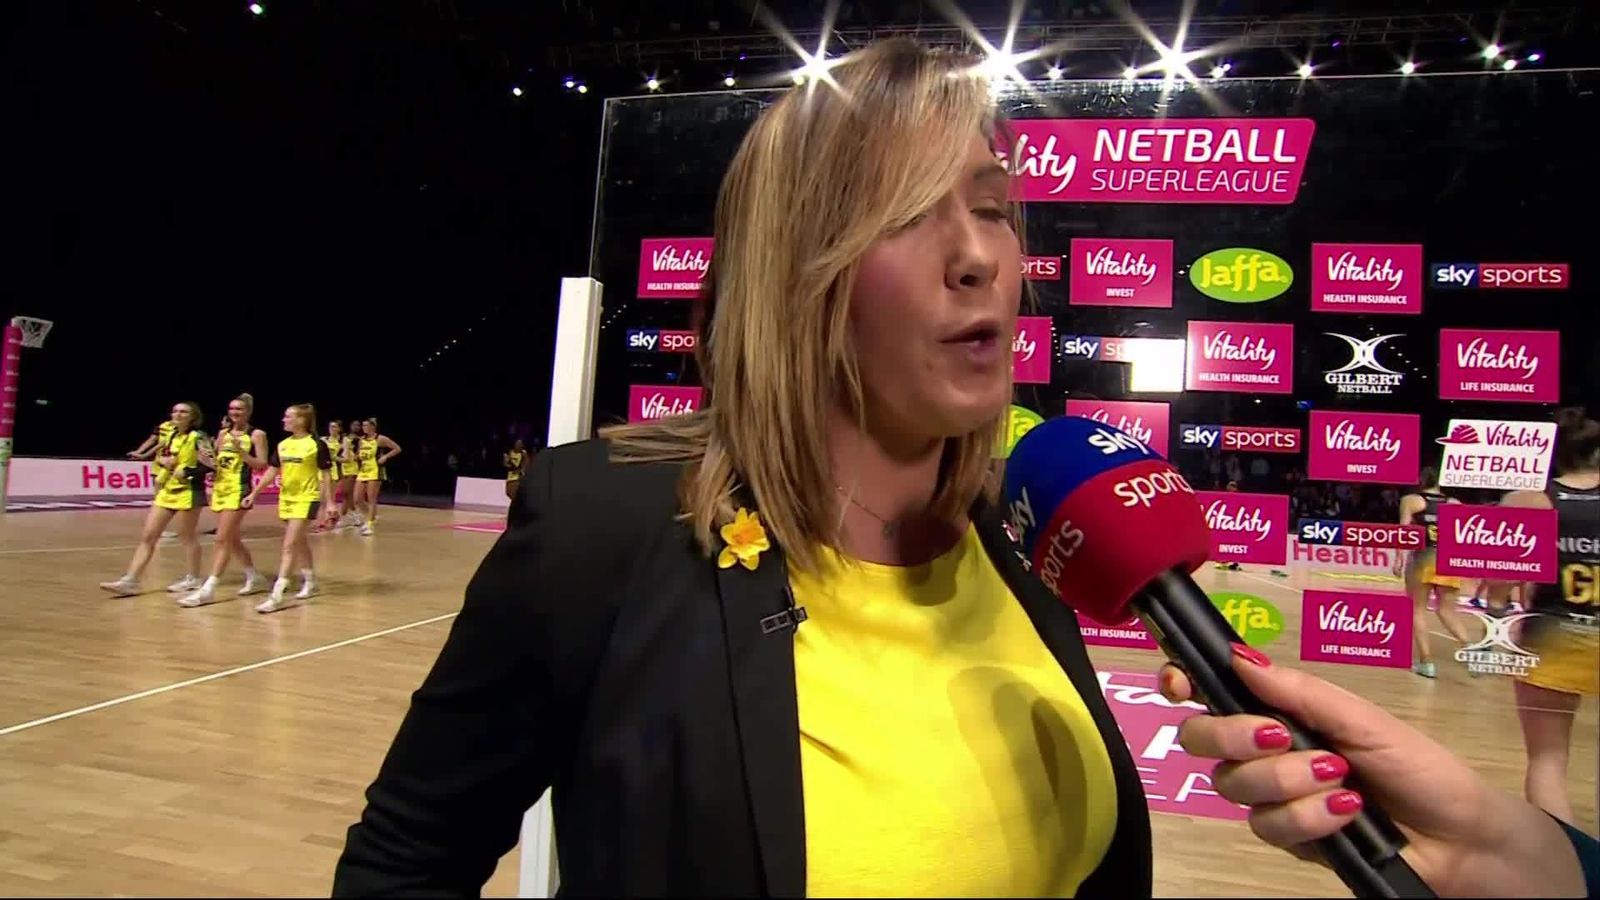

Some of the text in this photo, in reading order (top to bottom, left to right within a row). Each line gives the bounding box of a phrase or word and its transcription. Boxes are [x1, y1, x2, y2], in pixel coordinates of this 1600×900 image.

[1092, 128, 1297, 164] NETBALL
[1004, 133, 1077, 194] lity
[1090, 168, 1291, 194] SUPERLEAGUE
[653, 245, 709, 279] Vitality
[1020, 258, 1057, 276] orts
[1086, 246, 1156, 286] Vitality
[1328, 252, 1403, 291] Vitality
[1200, 254, 1283, 293] Jaffa
[1436, 265, 1562, 287] sky sports
[1106, 288, 1135, 298] INVEST
[1323, 294, 1407, 305] HEALTH INSURANCE
[630, 331, 695, 350] sky spo
[1065, 338, 1098, 359] sky
[1203, 331, 1276, 371] Vitality
[1457, 338, 1538, 379] Vitality
[1200, 373, 1280, 384] HEALTH INSURANCE
[1325, 373, 1403, 386] GILBERT
[1337, 384, 1392, 394] NETBALL
[1460, 382, 1535, 393] LIFE INSURANCE
[1088, 428, 1150, 454] sky
[1183, 424, 1295, 449] sky sports
[1326, 420, 1401, 461] Vitality
[1486, 423, 1549, 455] Vitality
[1347, 464, 1377, 474] INVEST
[1445, 454, 1544, 474] NETBALL
[82, 465, 157, 488] Heal
[1444, 474, 1541, 488] SUPERLEAGUE
[1200, 500, 1271, 541] Vitality
[1303, 522, 1339, 544] sky
[1346, 527, 1420, 545] sports
[1455, 514, 1536, 558] Vitality
[1219, 544, 1248, 553] INVEST
[1293, 540, 1389, 567] Health
[1450, 558, 1541, 572] HEALTH INSURANCE
[1319, 601, 1395, 644] Vitality
[1100, 628, 1147, 640] INSURANCE
[1321, 645, 1391, 658] LIFE INSURANCE
[1455, 651, 1540, 667] GILBERT
[1468, 664, 1530, 676] NETBALL
